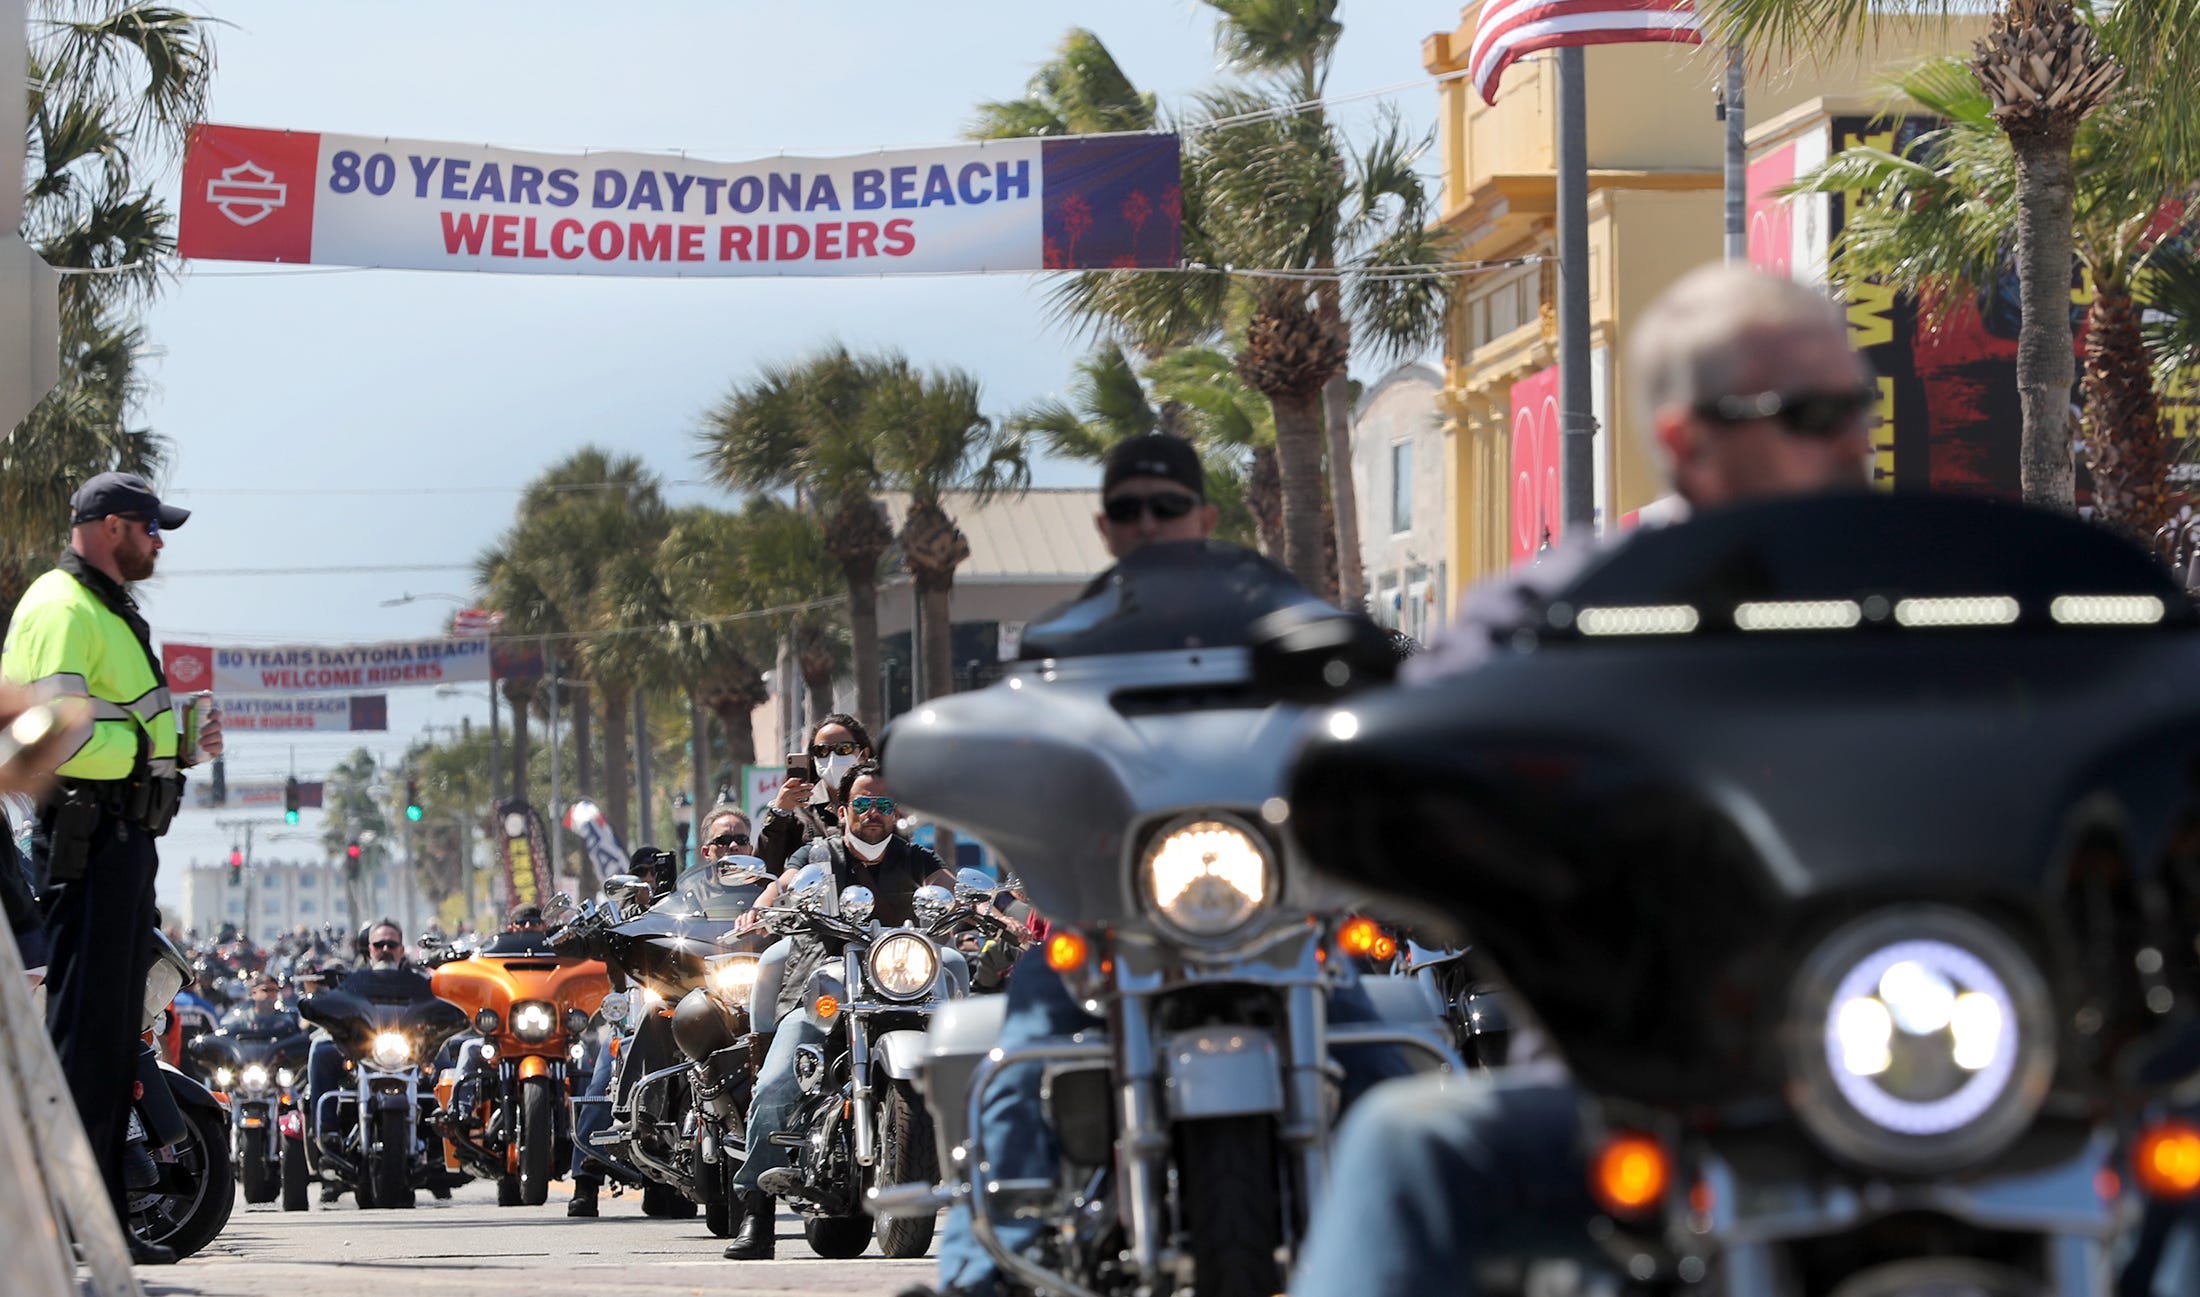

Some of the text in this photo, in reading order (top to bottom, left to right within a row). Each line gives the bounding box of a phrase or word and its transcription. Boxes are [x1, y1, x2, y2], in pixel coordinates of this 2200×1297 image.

[328, 150, 1030, 214] 80 YEARS DAYTONA BEACH
[440, 211, 916, 262] WELCOME RIDERS
[218, 638, 486, 668] 80 YEARS DAYTONA BEACH
[262, 661, 444, 689] WELCOME RIDERS
[223, 700, 293, 713] DAYTONA
[297, 699, 347, 713] BEACH
